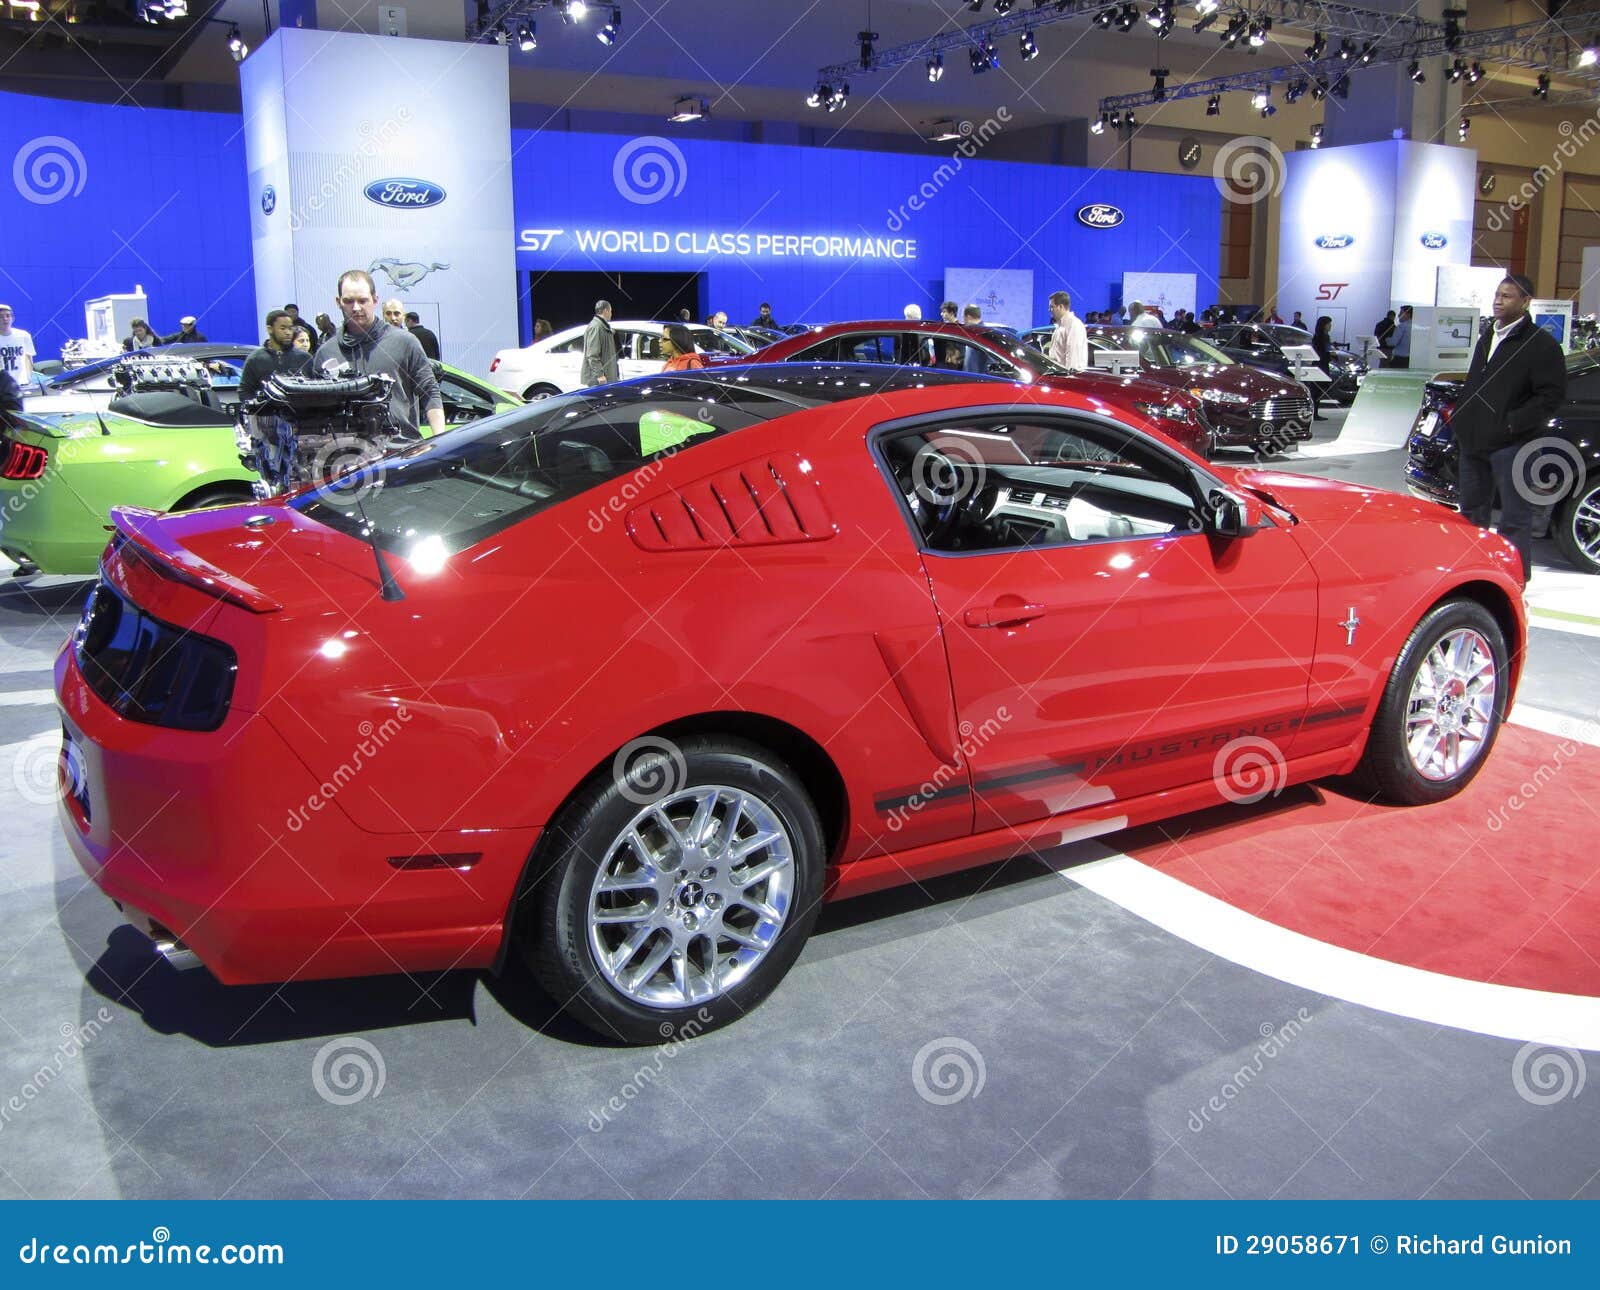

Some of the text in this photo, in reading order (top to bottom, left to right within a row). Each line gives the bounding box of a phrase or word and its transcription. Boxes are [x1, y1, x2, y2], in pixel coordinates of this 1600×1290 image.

[380, 182, 429, 204] Ford
[1088, 206, 1117, 224] Ford
[516, 229, 917, 258] ST WORLD CLASS PERFORMANCE
[1315, 283, 1350, 300] ST
[0, 345, 24, 357] OING
[1095, 721, 1282, 767] MUSTANG
